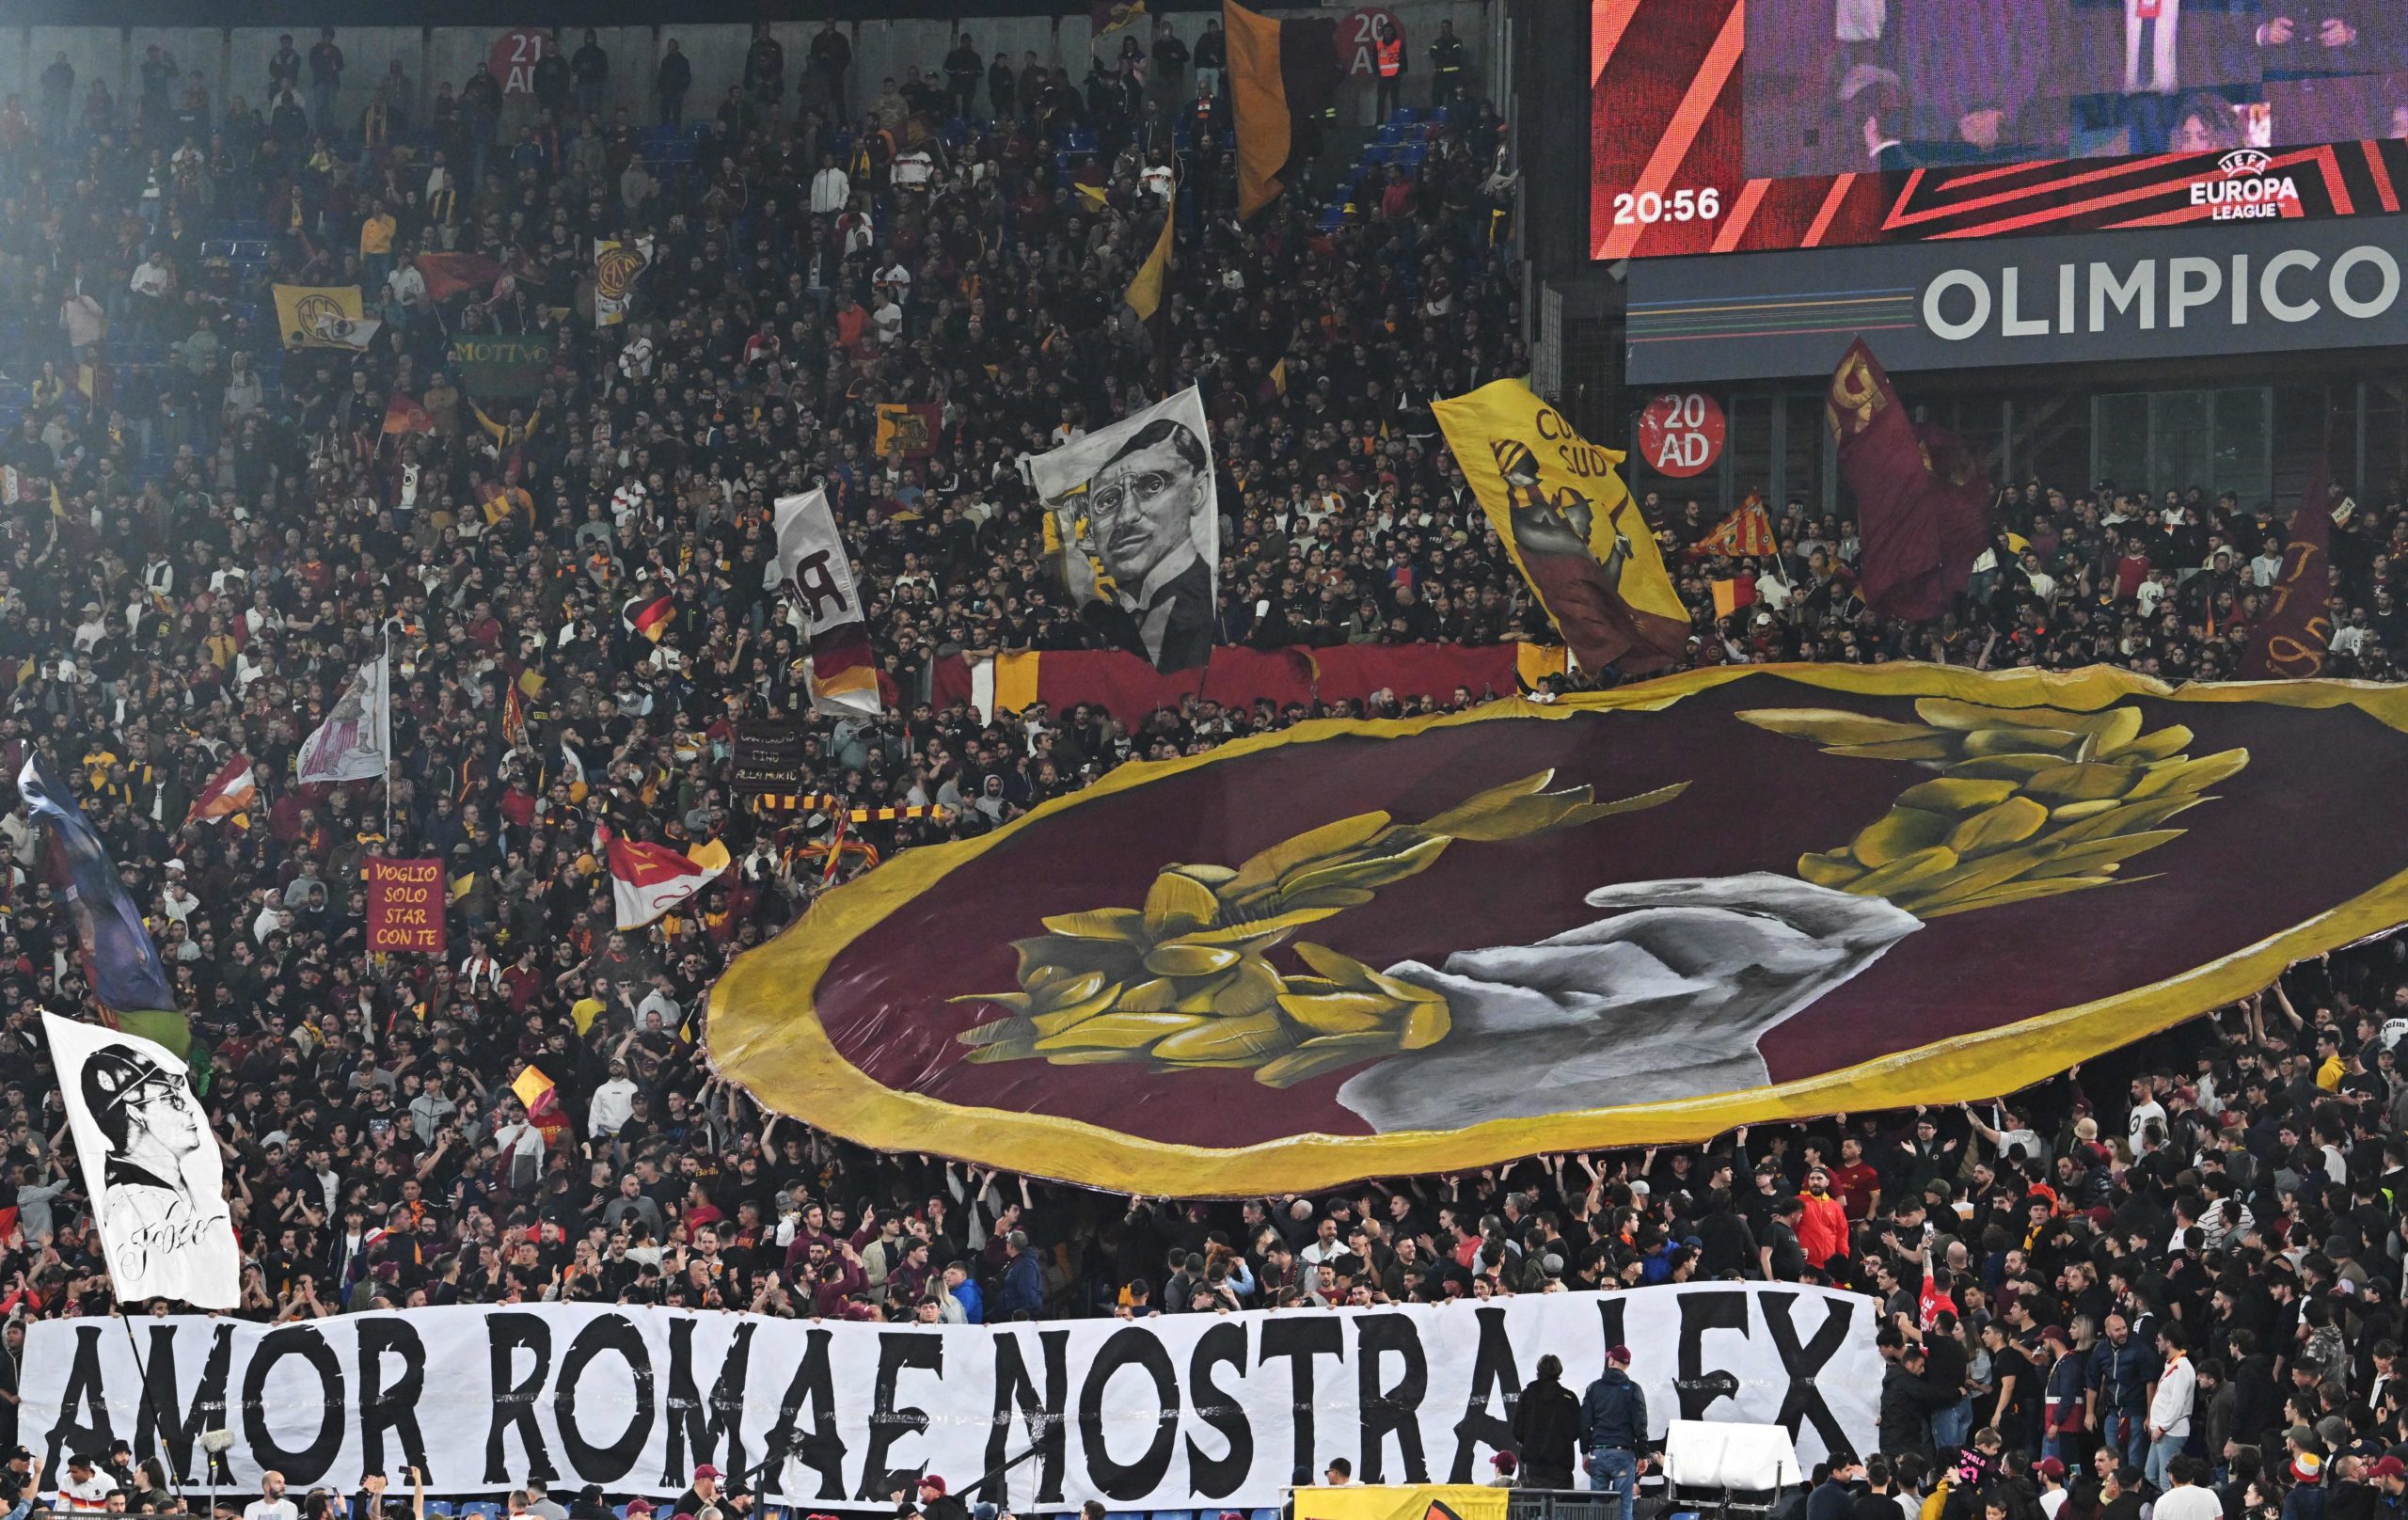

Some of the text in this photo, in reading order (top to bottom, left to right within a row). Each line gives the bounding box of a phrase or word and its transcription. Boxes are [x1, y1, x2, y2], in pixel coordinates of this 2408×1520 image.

[1354, 13, 1388, 42] 20
[511, 34, 542, 62] 21
[2221, 153, 2268, 173] UEFA
[2190, 177, 2299, 205] EUROPA
[1613, 187, 1719, 225] 20:56
[2212, 202, 2276, 221] LEAGUE
[1923, 245, 2400, 340] OLIMPICO
[454, 342, 548, 363] MOTIVO
[1664, 393, 1705, 429] 20
[1559, 444, 1608, 478] SUD
[1657, 433, 1709, 467] AD
[375, 863, 437, 883] VOGLIO
[384, 886, 428, 903] SOLO
[385, 907, 427, 925] STAR
[376, 927, 437, 946] CON TE
[38, 1318, 433, 1492] AMOR
[483, 1313, 943, 1502] ROMAE
[977, 1307, 1523, 1503] NOSTRA
